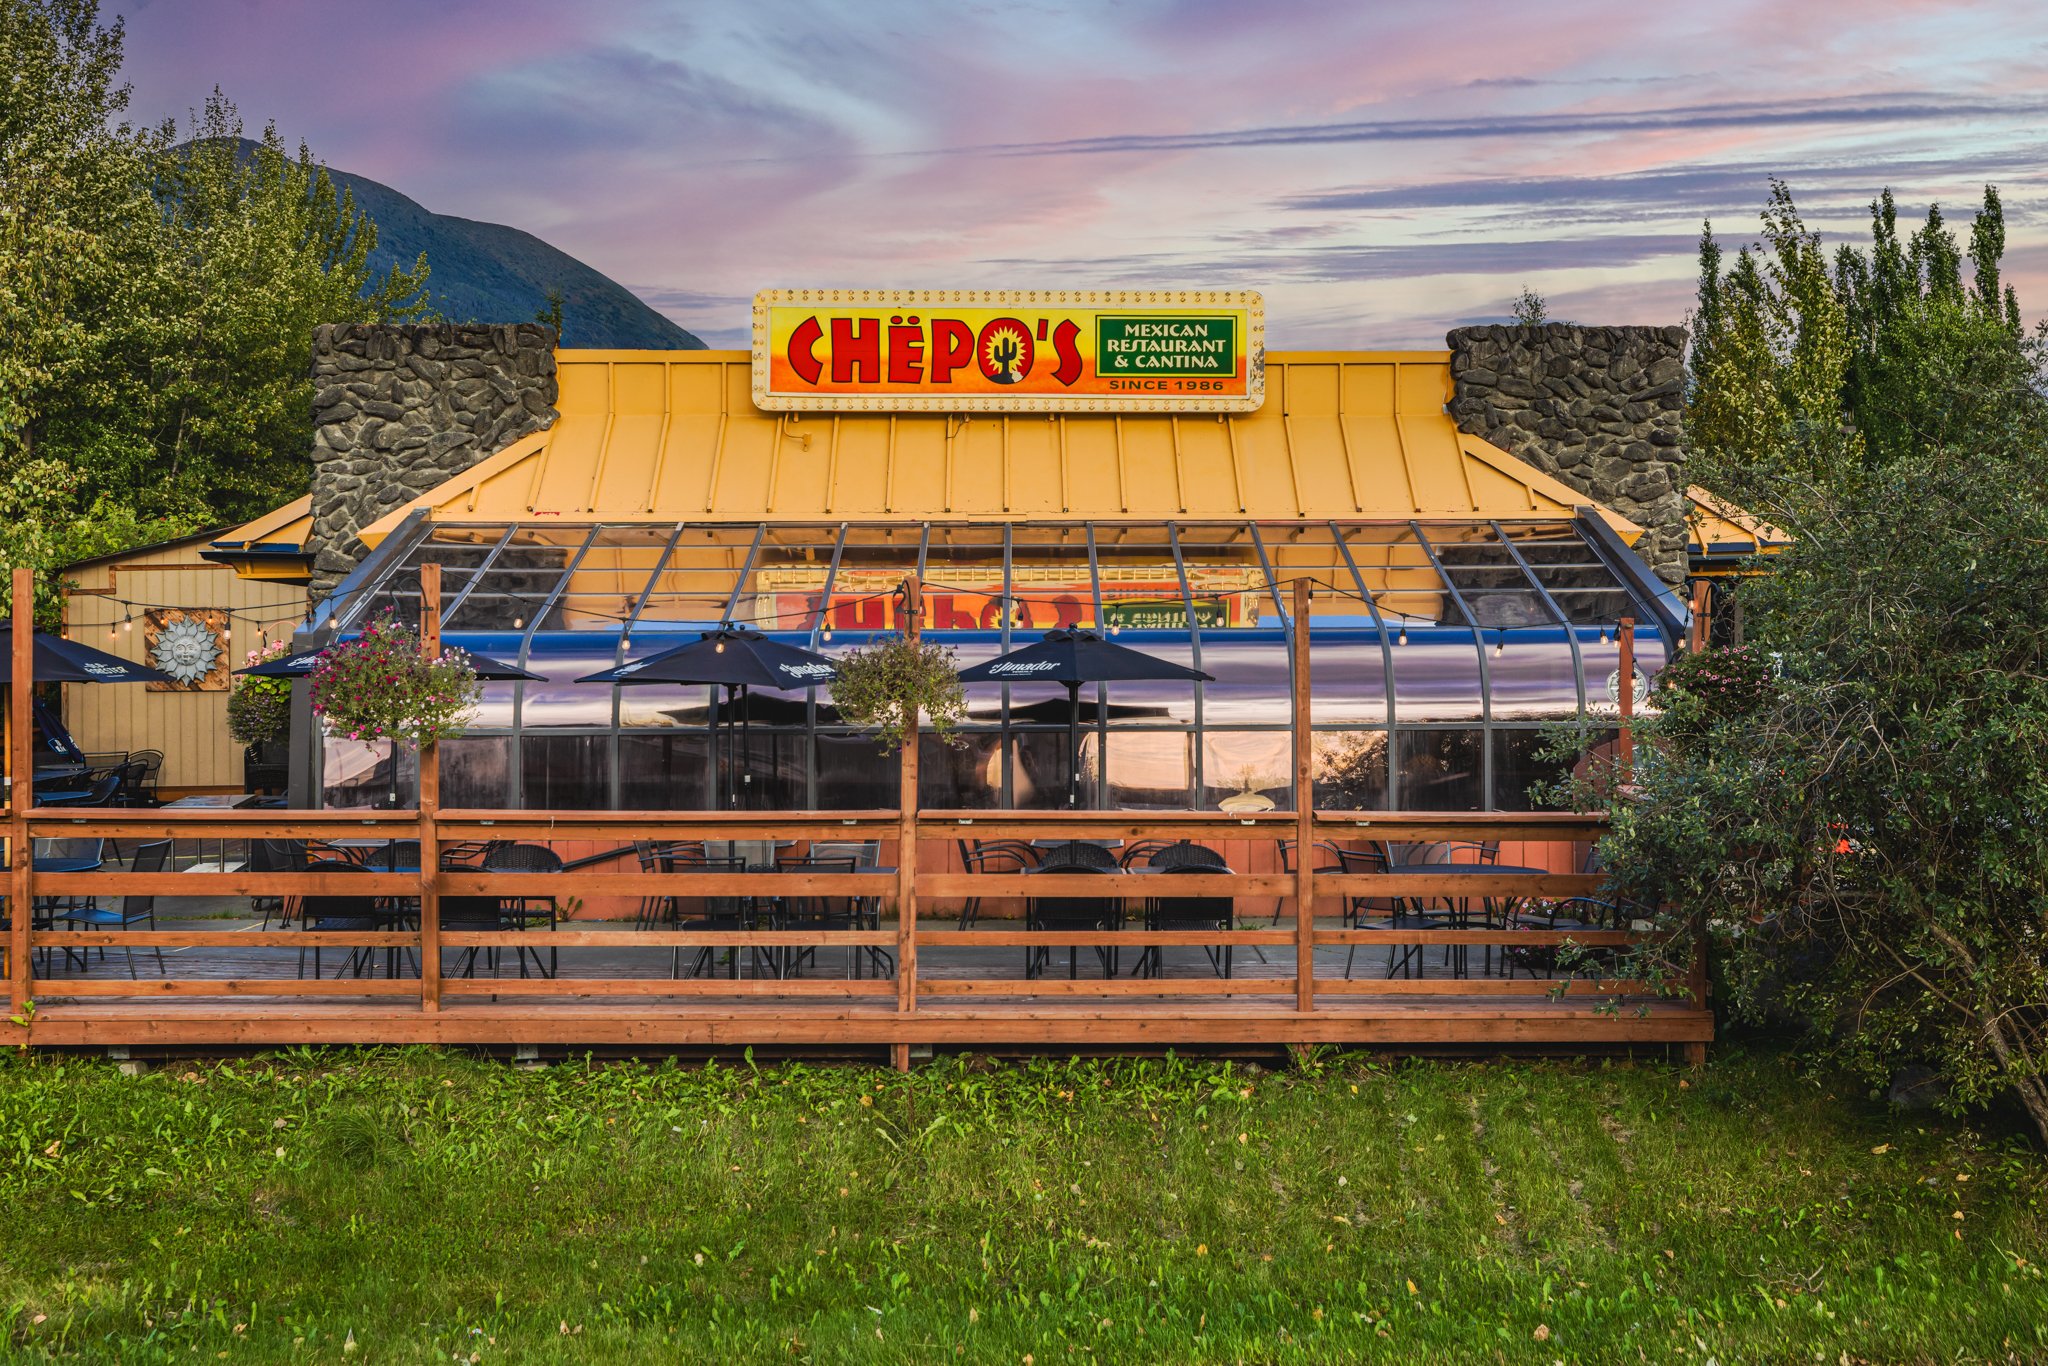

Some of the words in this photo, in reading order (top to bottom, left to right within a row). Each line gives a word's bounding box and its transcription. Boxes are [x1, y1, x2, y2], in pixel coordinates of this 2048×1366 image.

[1124, 323, 1208, 337] MEXICAN
[787, 315, 1083, 387] CHËPO'S
[1107, 339, 1227, 353] RESTAURANT
[1114, 354, 1129, 368] &
[1135, 355, 1219, 368] CANTINA
[1109, 380, 1168, 390] SINCE
[1174, 380, 1224, 391] 1986
[988, 661, 1061, 674] Jimador
